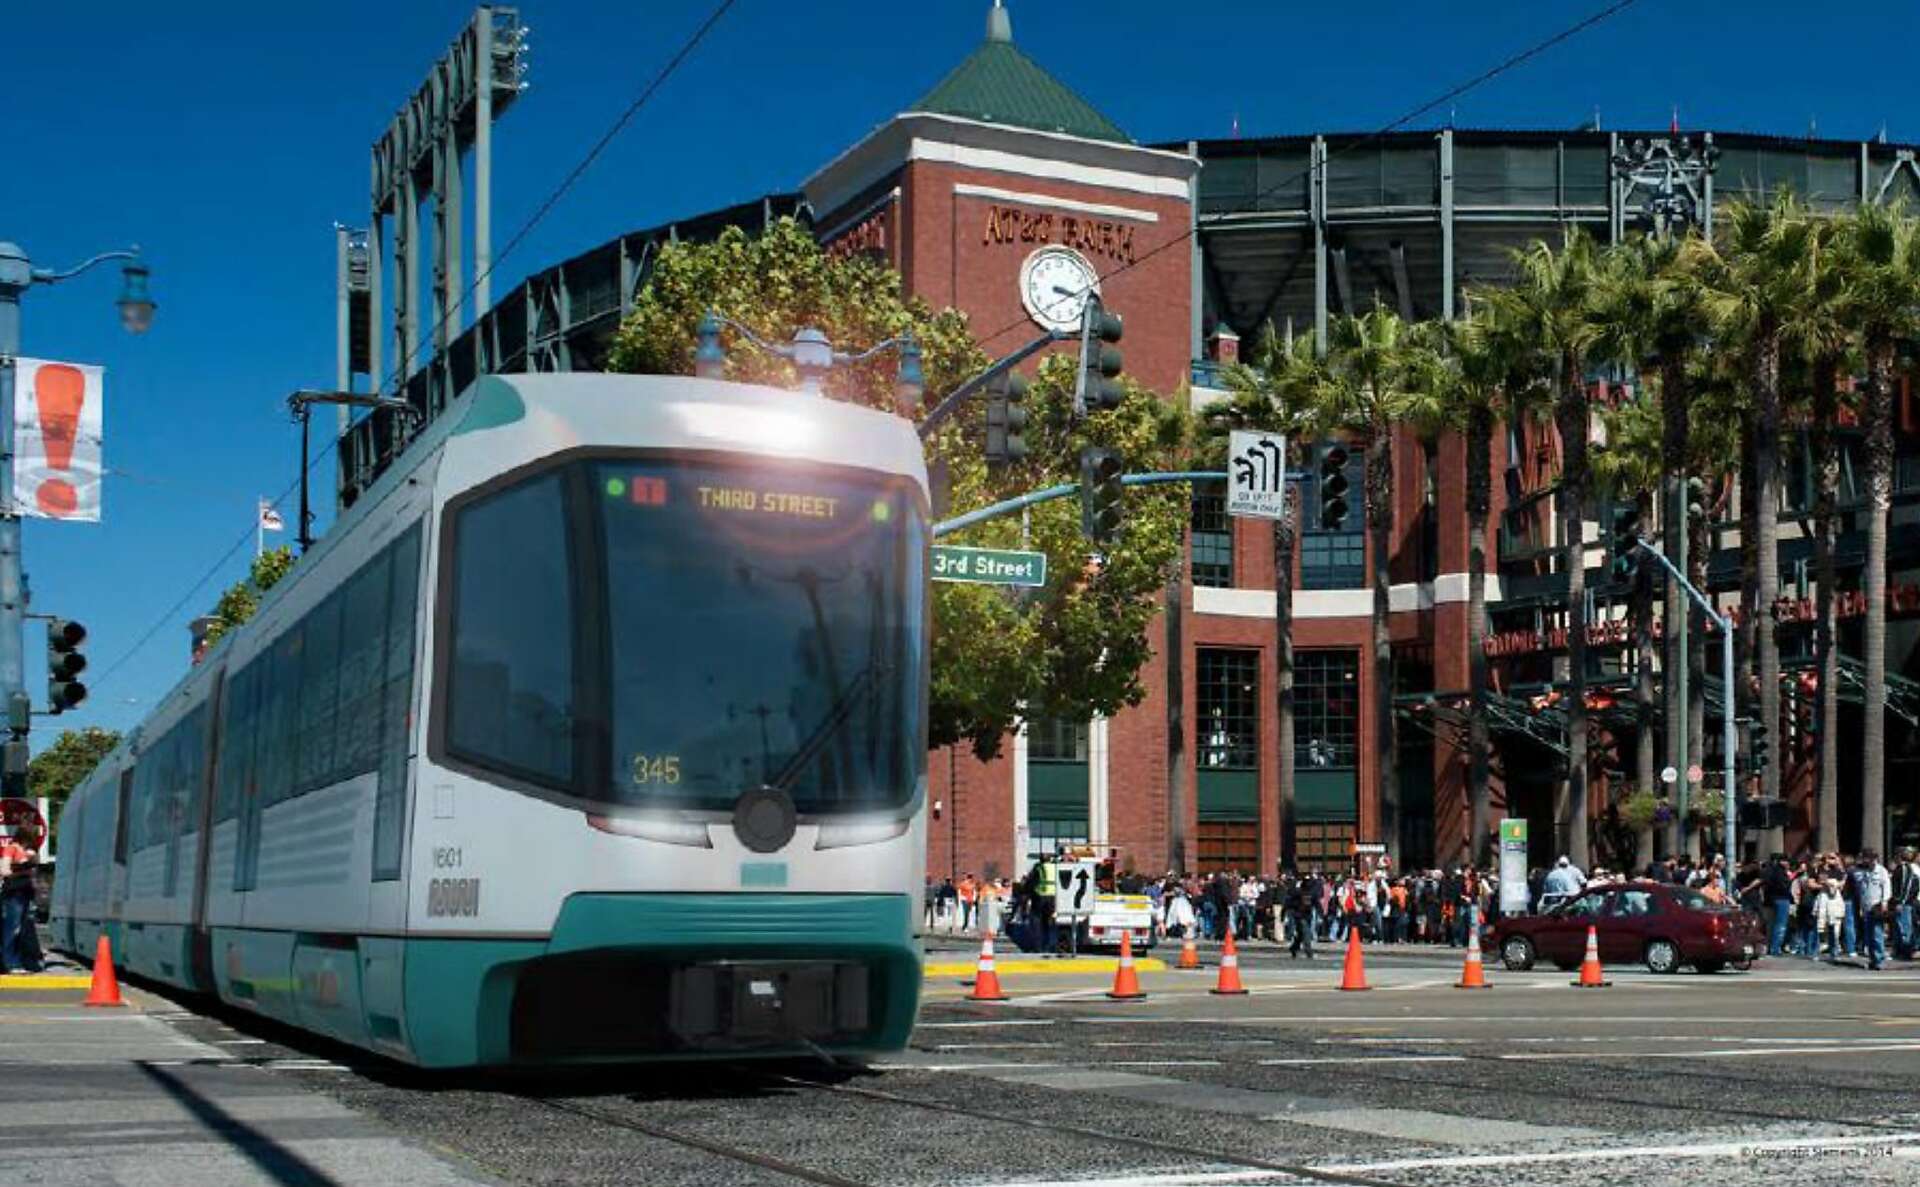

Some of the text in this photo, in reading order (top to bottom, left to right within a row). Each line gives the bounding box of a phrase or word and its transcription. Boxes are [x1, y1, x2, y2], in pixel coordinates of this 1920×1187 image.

[982, 205, 1136, 266] AT&T PARK
[698, 487, 838, 518] THIRD STREET
[934, 553, 1032, 577] 3rd Street
[632, 755, 680, 784] 345
[433, 847, 462, 868] 1601
